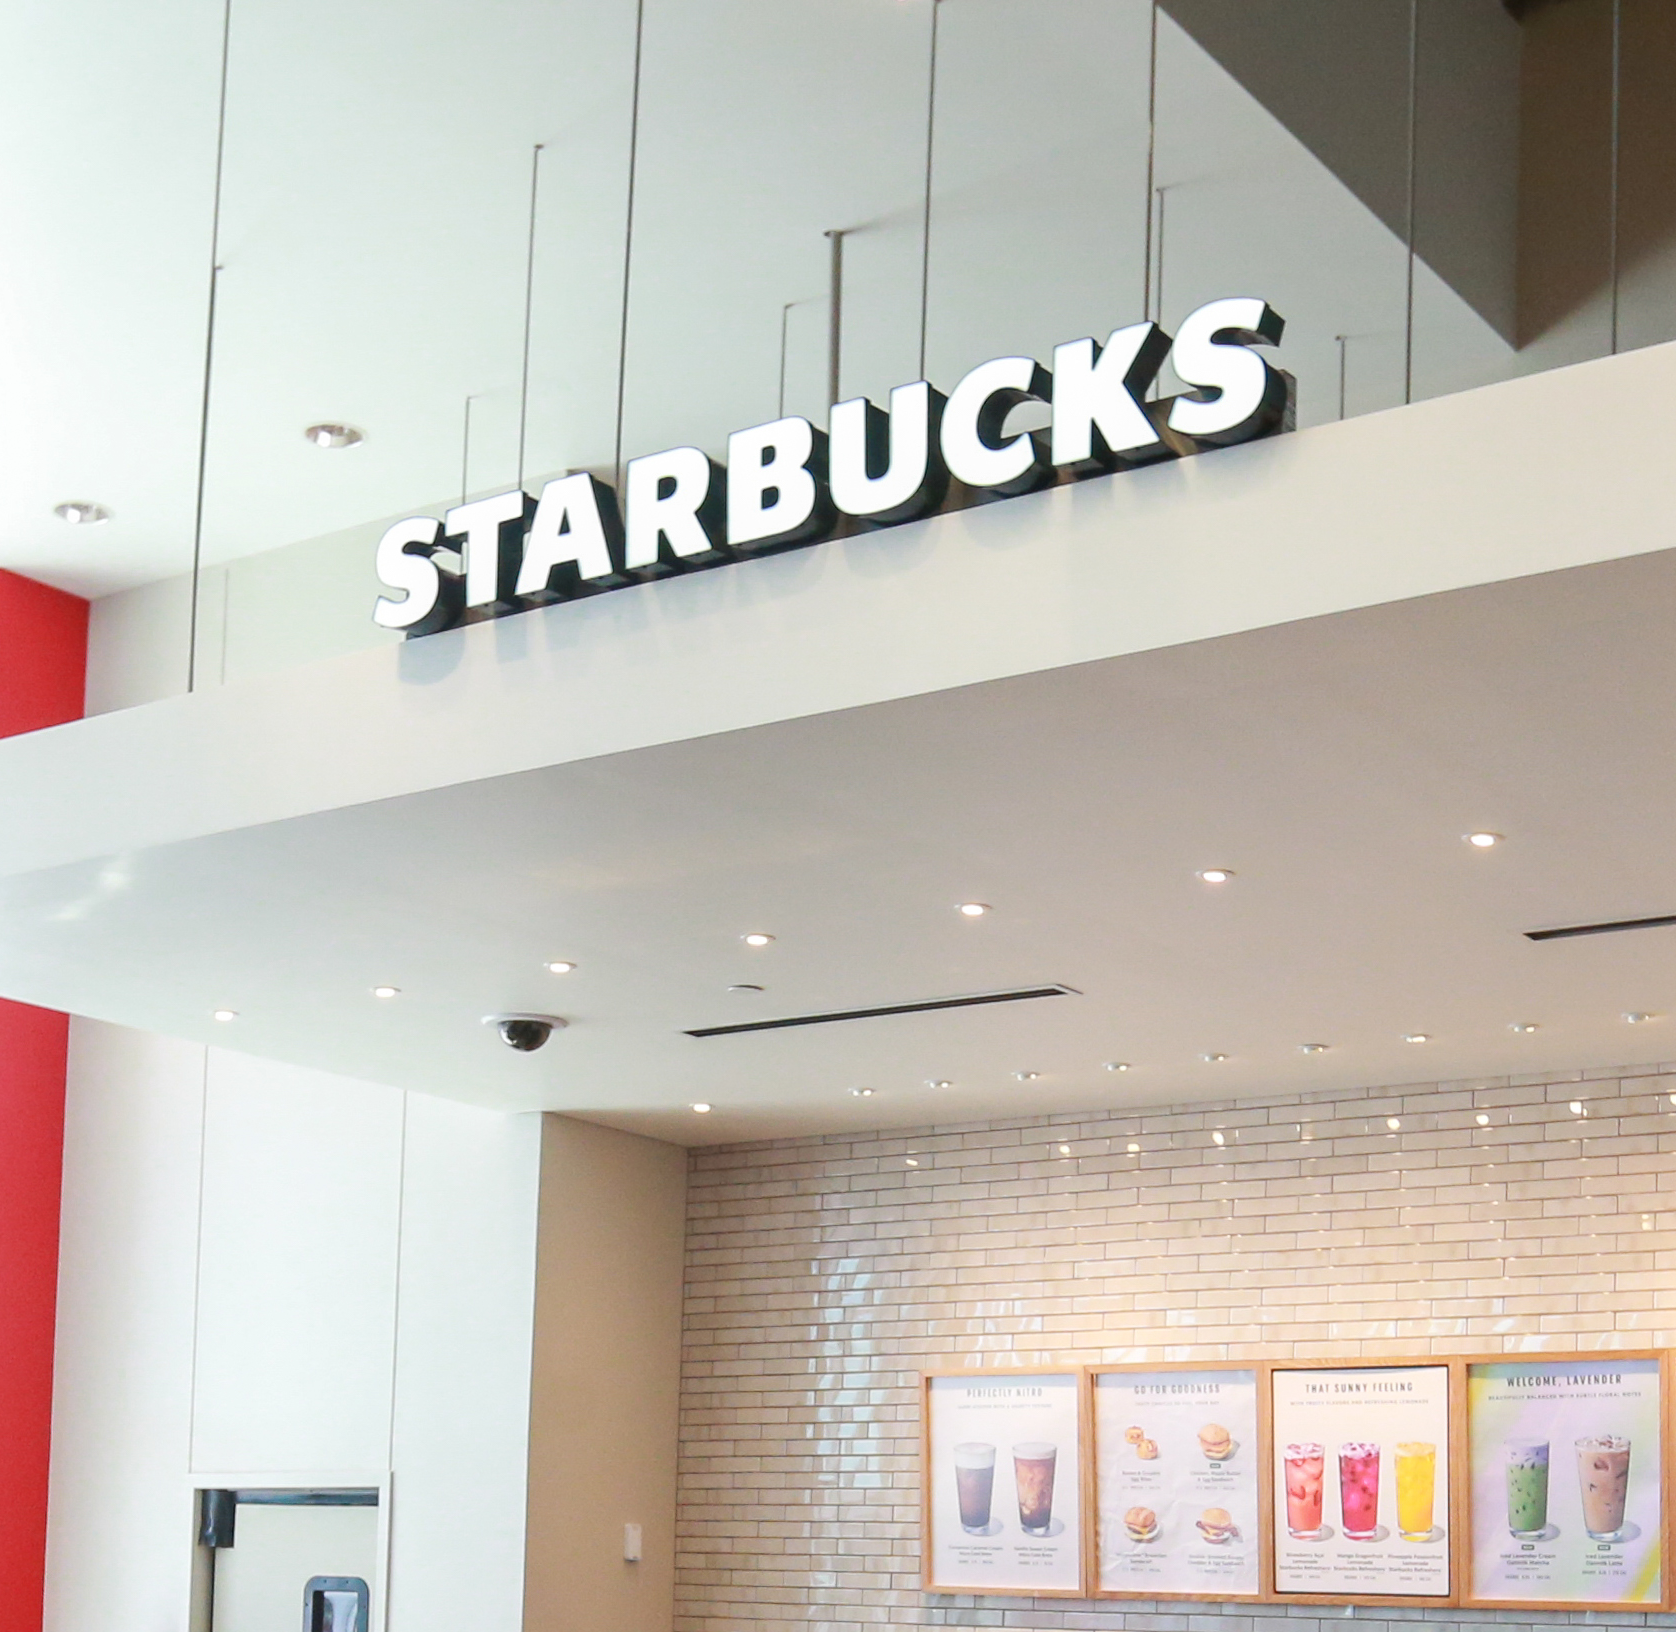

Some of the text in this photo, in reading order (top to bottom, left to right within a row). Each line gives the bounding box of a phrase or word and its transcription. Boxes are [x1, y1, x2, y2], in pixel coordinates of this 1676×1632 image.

[373, 297, 1281, 632] STARBUCKS
[1507, 1374, 1622, 1388] WELCOME, LAVENDER
[967, 1387, 1042, 1398] PERFECTLY NITRO
[1134, 1384, 1221, 1394] GO FOR GOODNESS
[1305, 1382, 1413, 1393] THAT SUNNY FEELING
